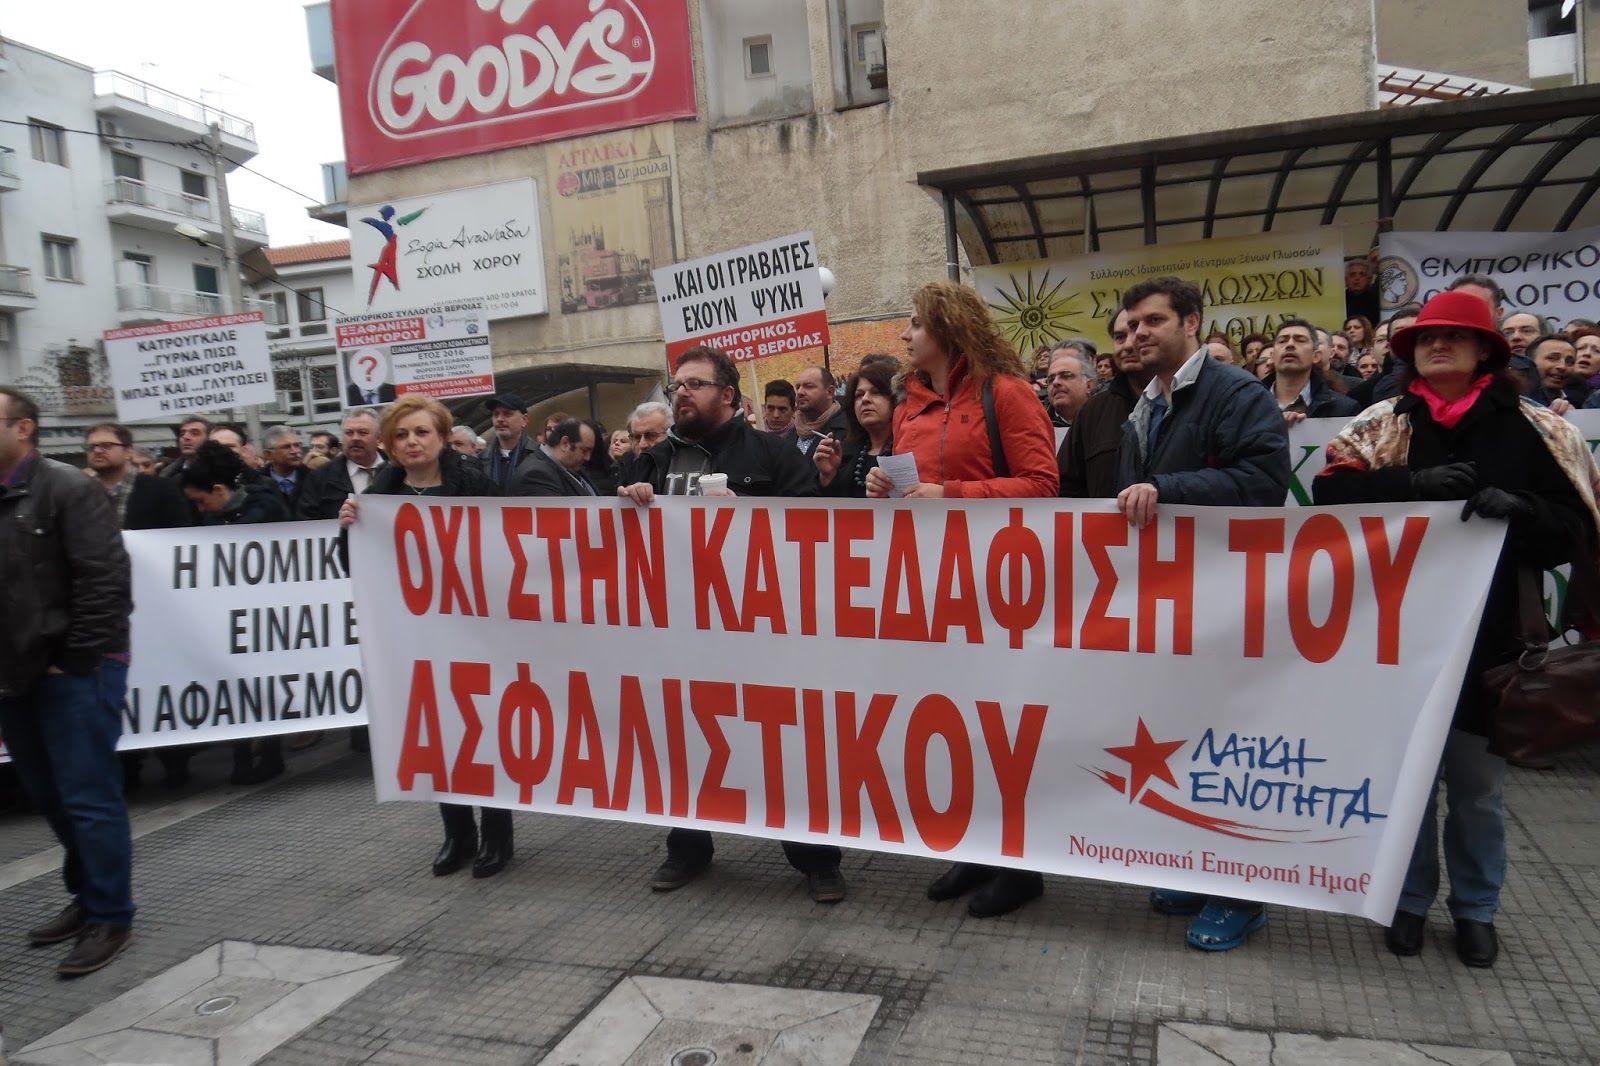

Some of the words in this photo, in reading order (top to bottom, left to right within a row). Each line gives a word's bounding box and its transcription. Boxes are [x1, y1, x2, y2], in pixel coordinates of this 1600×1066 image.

[617, 161, 668, 180] Δημούλα
[416, 262, 461, 279] ΣΧΟΛΗ
[473, 253, 521, 271] ΧΟΡΟΥ
[706, 262, 725, 291] ΟΙ
[727, 240, 814, 286] ΓΡΑΒΑΤΕΣ
[1090, 267, 1135, 281] Σύλλογος
[1137, 260, 1191, 277] Ιδιοκτητών
[1193, 255, 1237, 271] Κέντρων
[1272, 247, 1321, 261] Γλωσσών
[1200, 267, 1325, 307] ΛΩΣΣΩΝ
[336, 312, 394, 324] ΔΙΚΗΓΟΡΙΚΟΣ
[396, 306, 442, 318] ΣΥΛΛΟΓΟΣ
[445, 303, 482, 312] ΒΕΡΟΙΑΣ
[682, 295, 738, 333] ΕΧΟΥΝ
[751, 280, 804, 316] ΨΥΧΗ
[107, 324, 170, 338] ΔΙΚΗΓΟΡΙΚΟΣ
[172, 319, 219, 332] ΣΥΛΛΟΓΟΣ
[221, 313, 260, 325] ΒΕΡΟΙΑΣ
[340, 319, 420, 336] ΕΞΑΦΑΝΙΣΗ
[137, 330, 237, 352] ΚΑΤΡΟΥΓΚΑΛΕ
[341, 330, 420, 347] ΔΙΚΗΓΟΡΟΥ
[758, 332, 823, 356] ΒΕΡΟΙΑΣ
[204, 346, 236, 360] ΠΙΣΩ
[418, 351, 440, 359] ΕΤΟΣ
[443, 349, 464, 357] 2016
[141, 370, 167, 382] ΣΤΗ
[172, 360, 244, 379] ΔΙΚΗΓΟΡΙΑ
[121, 385, 160, 400] ΜΠΑΣ
[165, 382, 187, 395] ΚΑΙ
[160, 400, 170, 410] Η
[174, 392, 234, 409] ΙΣΤΟΡΙΑ!!
[173, 544, 198, 590] Η
[213, 537, 350, 587] ΝΟΜΙΚ
[394, 502, 489, 616] ΟΧΙ
[502, 506, 668, 628] ΣΤΗΝ
[691, 507, 1195, 656] ΚΑΤΕΔΑΦΙΣΗ
[1228, 513, 1430, 665] ΤΟΥ
[230, 603, 330, 655] ΕΙΝΑΙ
[397, 660, 1049, 858] ΑΣΦΑΛΙΣΤΙΚΟΥ
[1189, 771, 1388, 828] ΕΝΟΤΗΤΑ
[1069, 834, 1193, 871] Νομαρχιακή
[1201, 850, 1301, 885] Επιτροπή
